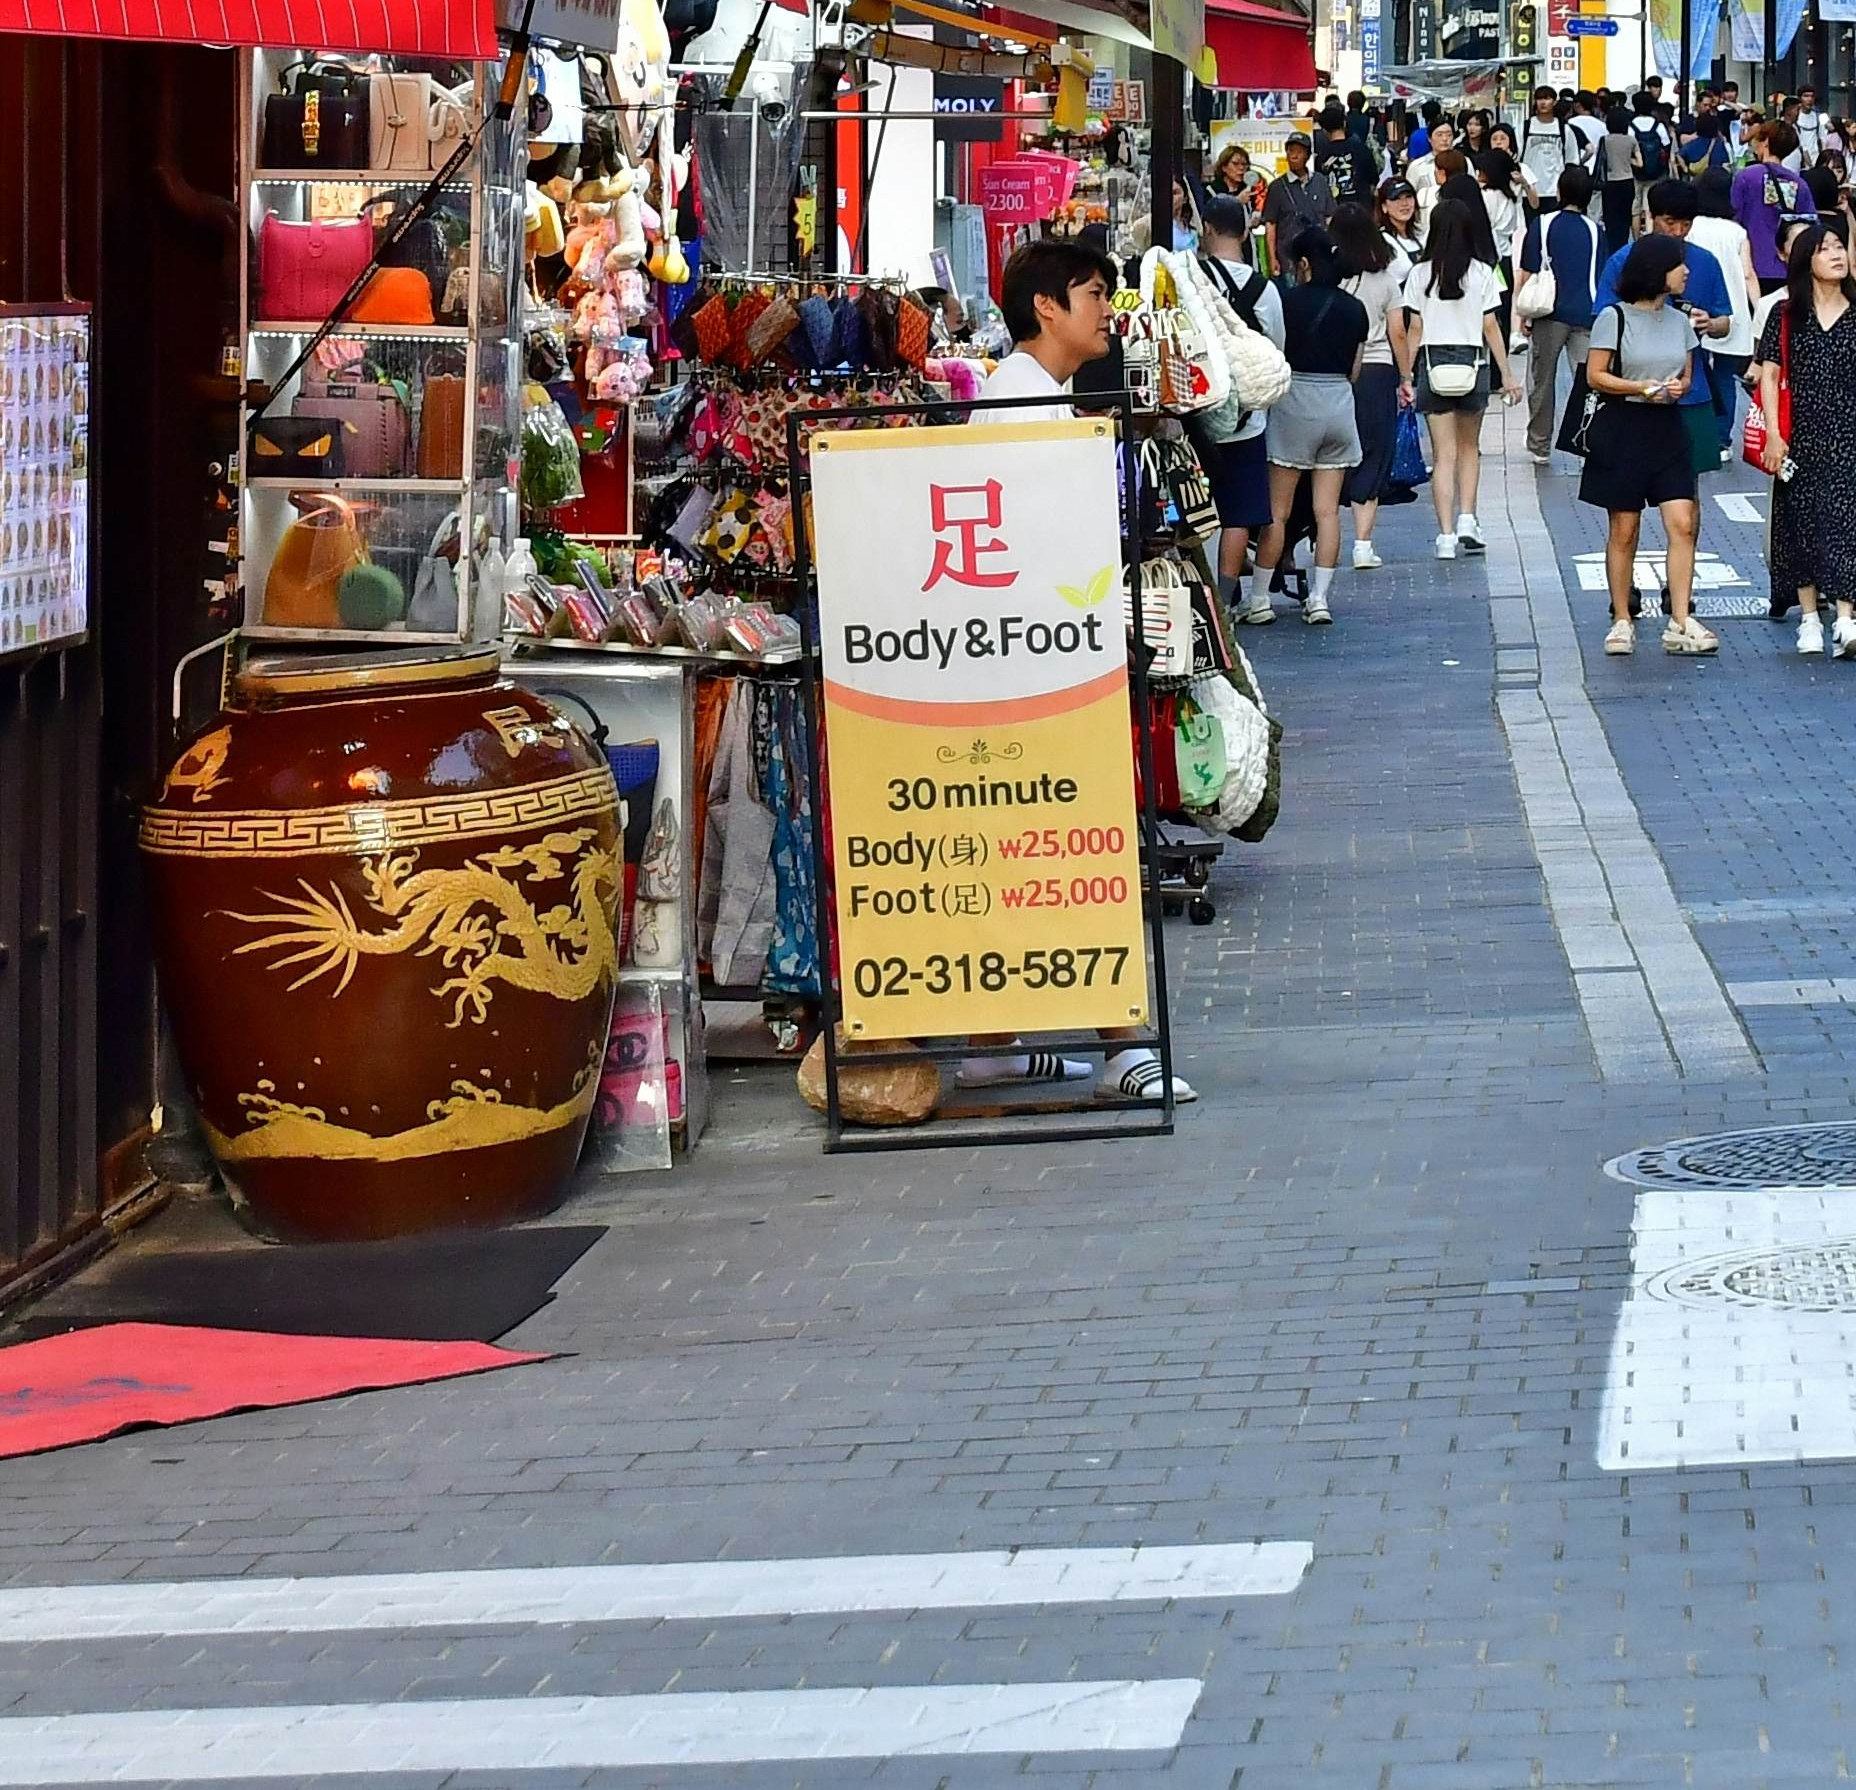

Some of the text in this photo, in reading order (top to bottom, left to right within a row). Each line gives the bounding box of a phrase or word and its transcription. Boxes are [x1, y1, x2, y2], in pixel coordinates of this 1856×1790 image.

[982, 178, 1030, 191] Sun Cream
[989, 194, 1024, 211] 2300
[921, 477, 1021, 593] 足
[845, 613, 1105, 670] Body&Foot
[887, 772, 1078, 813] 30 minute
[852, 944, 1132, 1002] 02-318-5877
